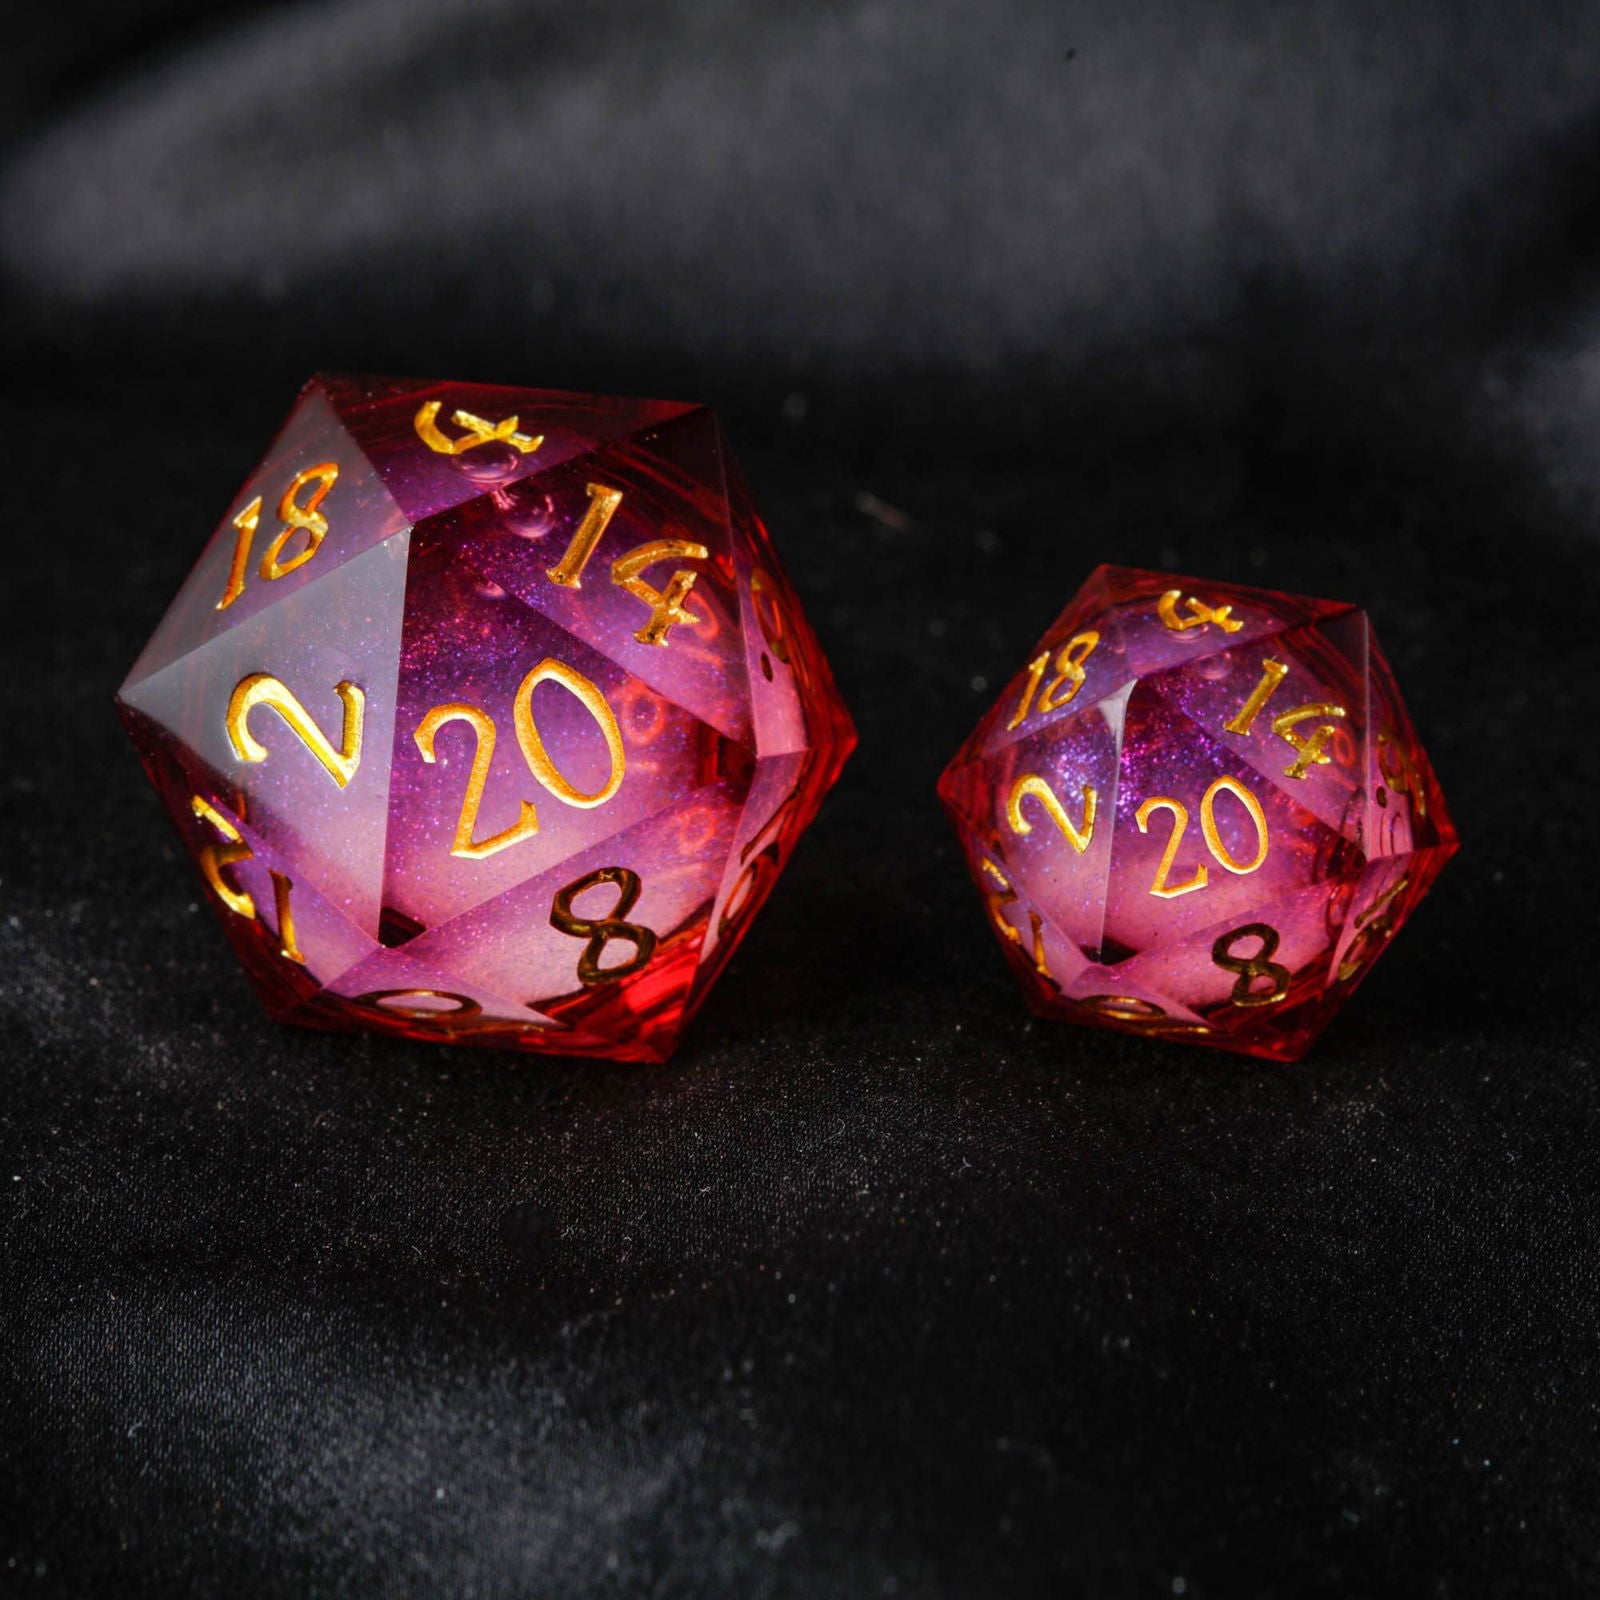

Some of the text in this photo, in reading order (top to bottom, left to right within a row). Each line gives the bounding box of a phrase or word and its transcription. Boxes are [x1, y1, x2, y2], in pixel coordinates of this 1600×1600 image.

[413, 400, 545, 455] 4
[215, 461, 339, 611] 18
[545, 482, 709, 647] 14
[1157, 589, 1244, 633] 4
[225, 671, 366, 790] 2
[1006, 631, 1100, 732] 18
[1223, 658, 1346, 780] 14
[413, 656, 626, 860] 20
[1006, 772, 1098, 856] 2
[1134, 775, 1269, 899] 20
[549, 866, 659, 987] 8
[1211, 922, 1292, 1008] 8
